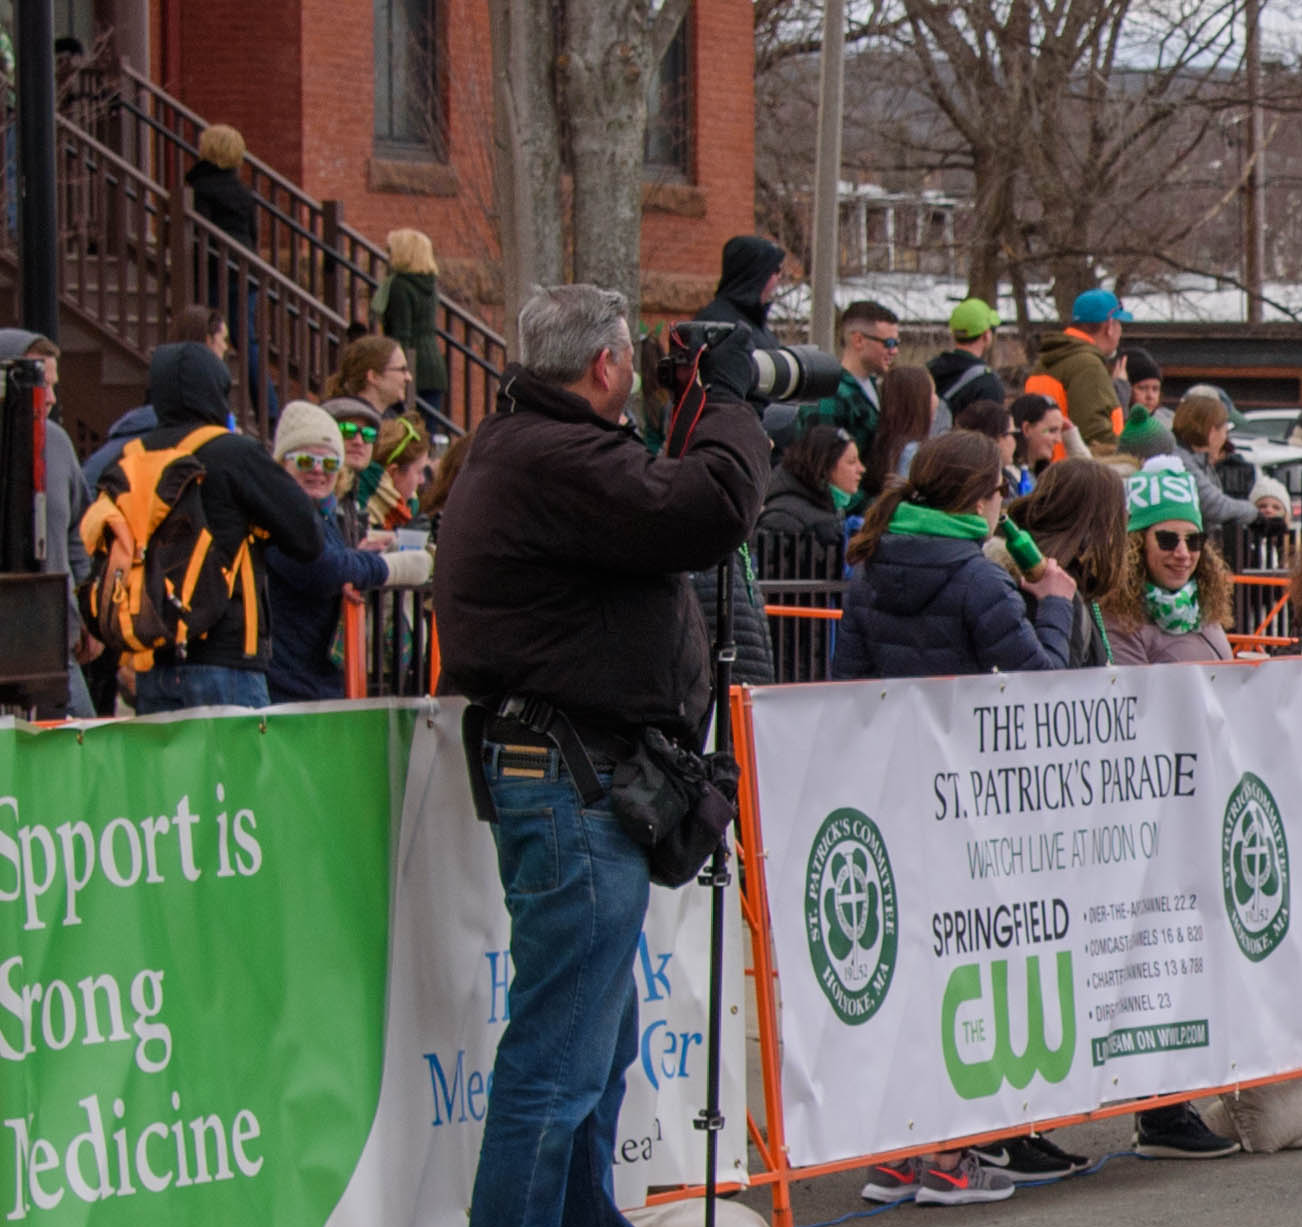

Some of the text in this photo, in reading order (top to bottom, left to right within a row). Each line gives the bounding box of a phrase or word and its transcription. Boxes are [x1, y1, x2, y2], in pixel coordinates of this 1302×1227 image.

[973, 696, 1138, 753] THE HOLYOKE
[934, 753, 1198, 822] ST. PATRICK'S PARADE
[216, 783, 262, 877] is
[966, 837, 1024, 881] WATCH
[1029, 831, 1066, 873] LIVE
[1071, 828, 1089, 868] AT
[1092, 823, 1136, 865] NOON
[809, 818, 851, 900] PATRICK'S
[852, 820, 895, 936] COMMITTEE
[932, 898, 1070, 958] SPRINGFIELD
[1162, 928, 1174, 944] 16
[1177, 926, 1185, 942] &
[872, 962, 889, 997] MA
[1164, 959, 1178, 977] 13
[1181, 959, 1188, 975] &
[1158, 993, 1171, 1009] 23
[961, 1018, 987, 1045] THE
[1136, 1029, 1156, 1051] ON
